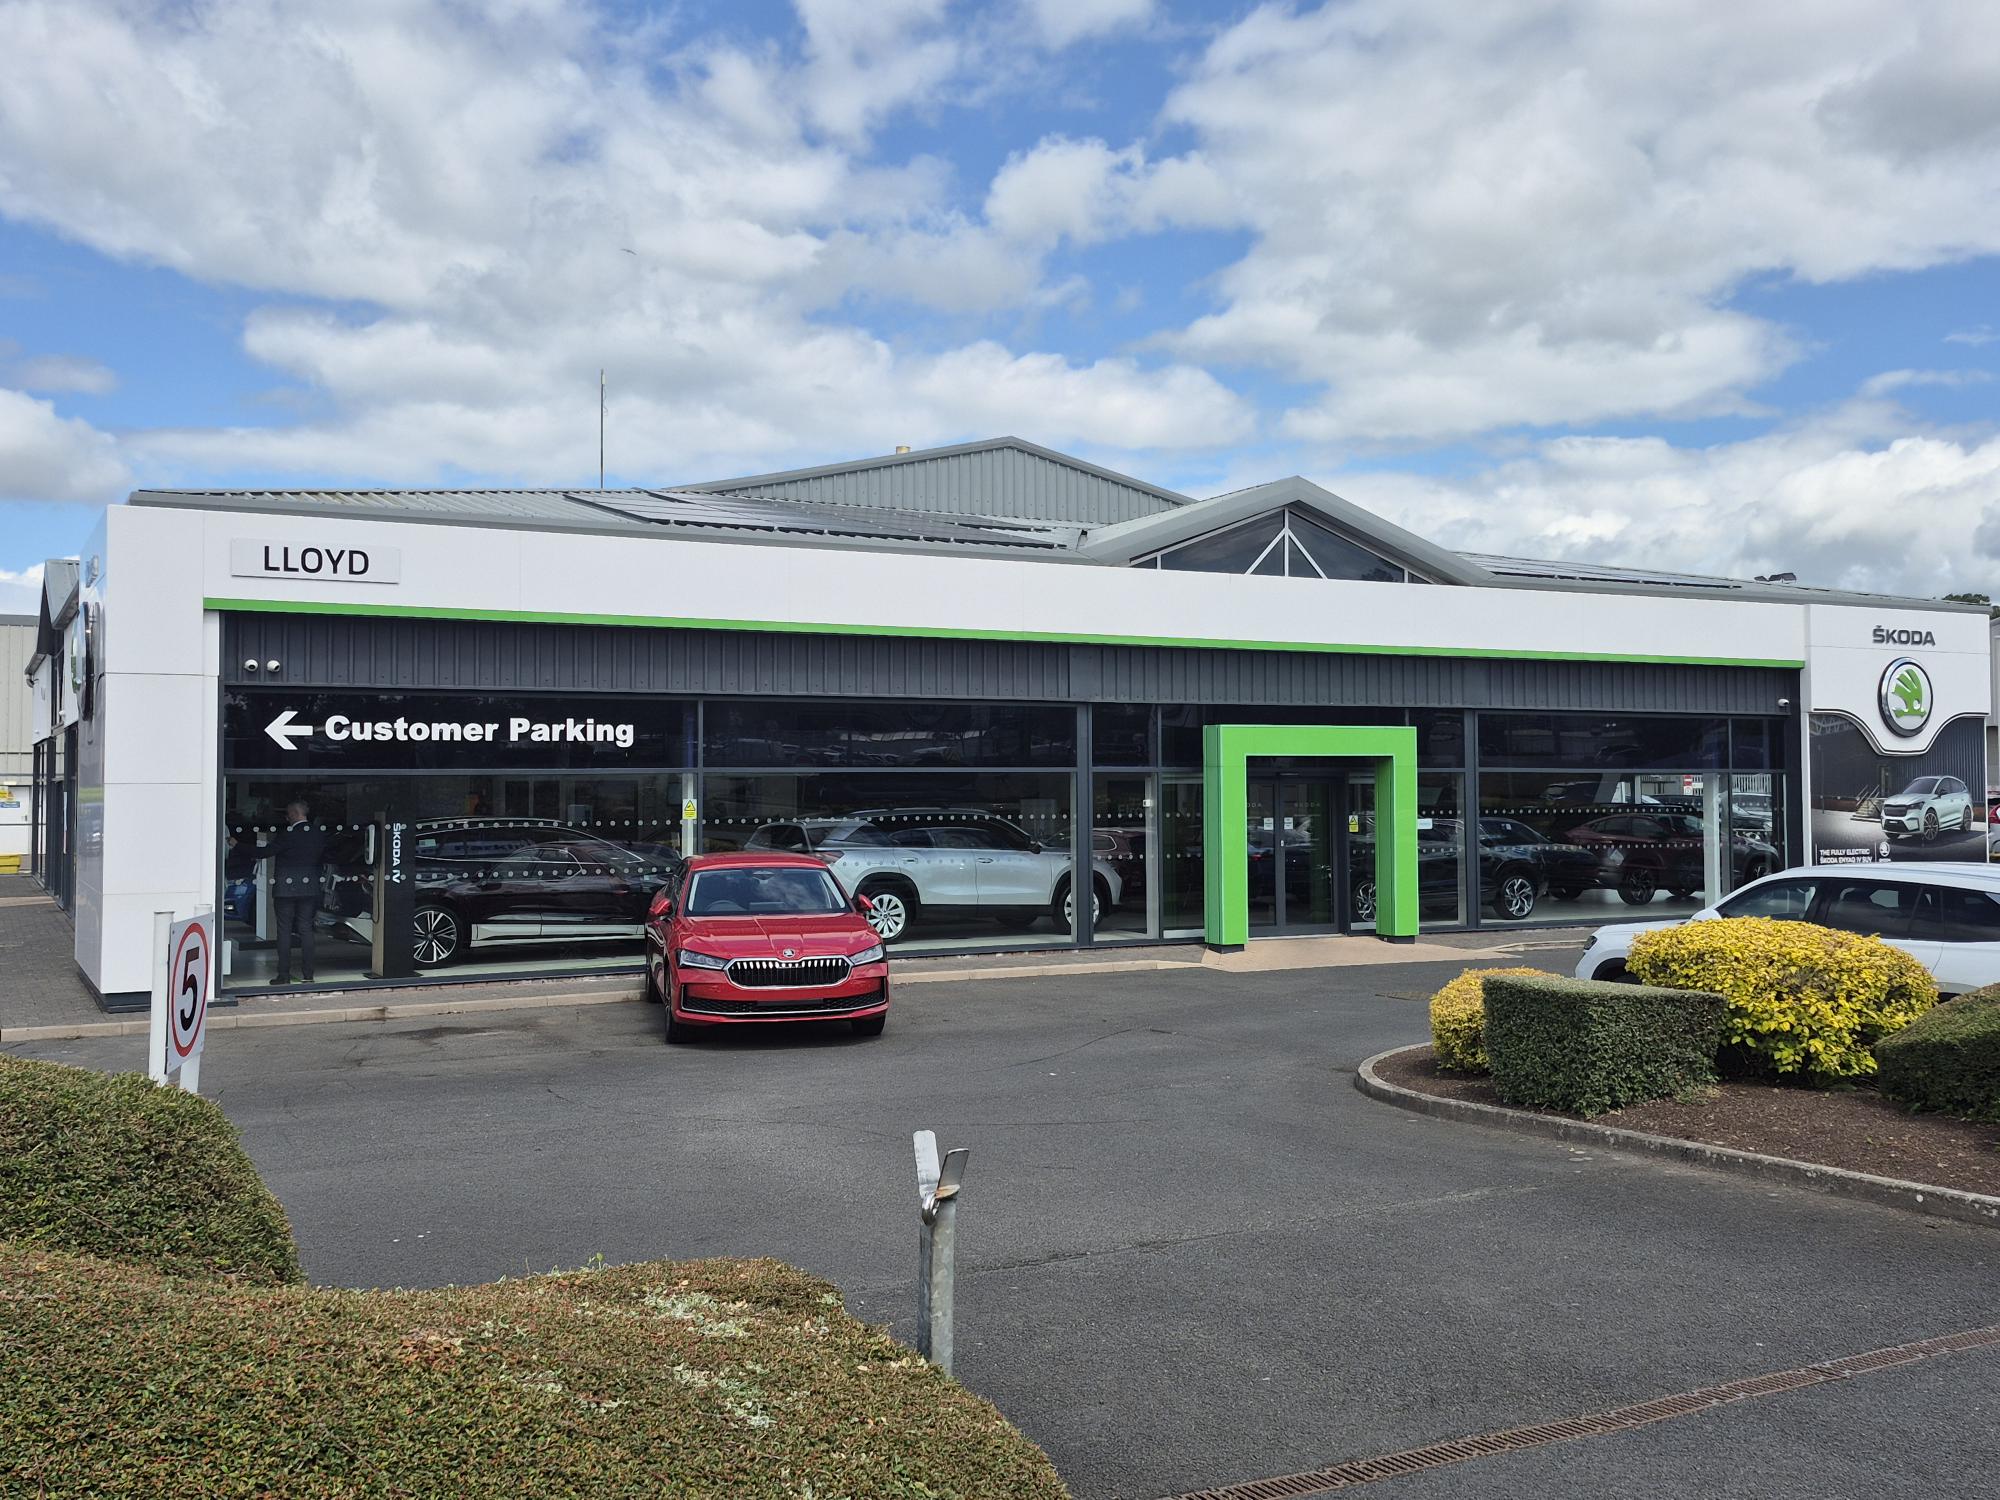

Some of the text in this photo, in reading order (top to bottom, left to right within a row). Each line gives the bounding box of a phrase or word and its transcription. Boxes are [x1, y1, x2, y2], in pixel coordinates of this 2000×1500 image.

[264, 545, 369, 575] LLOYD
[1872, 625, 1936, 646] ŠKODA
[324, 715, 634, 748] Customer Parking
[180, 946, 200, 1031] 5
